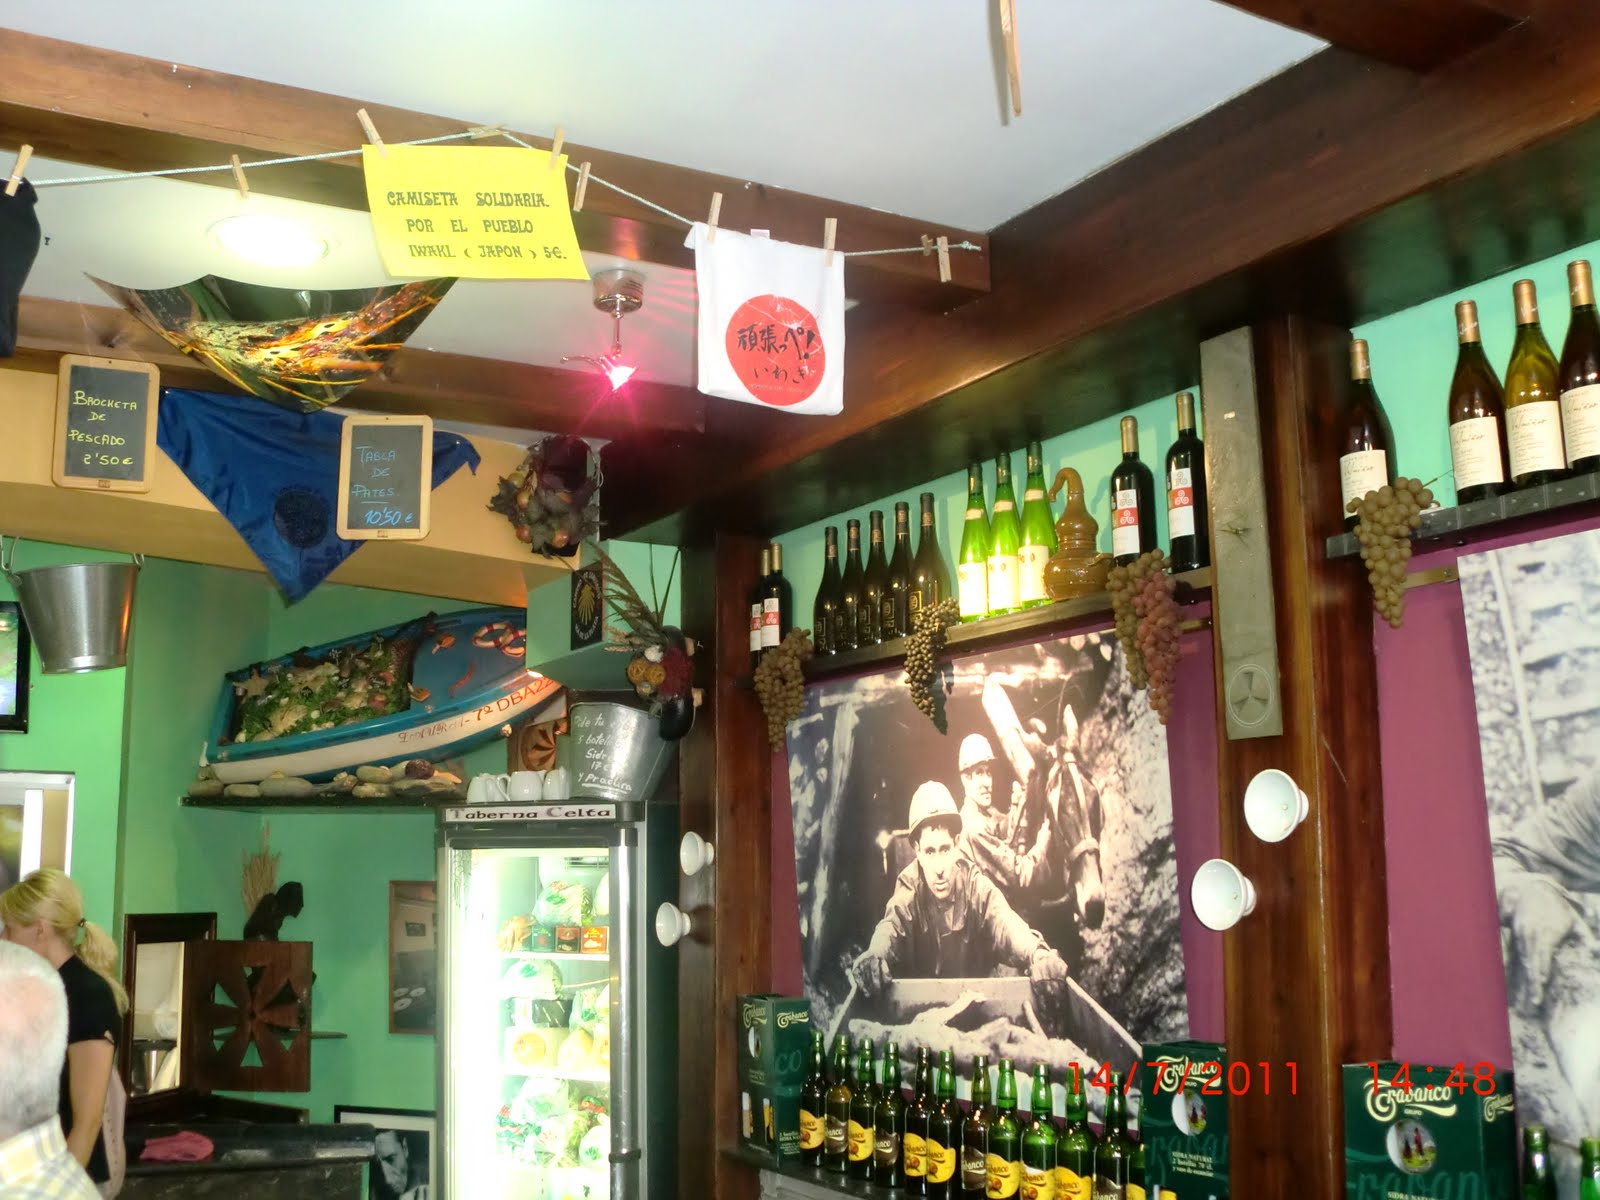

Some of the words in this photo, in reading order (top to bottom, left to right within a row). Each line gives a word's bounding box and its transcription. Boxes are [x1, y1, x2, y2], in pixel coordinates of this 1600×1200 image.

[387, 191, 459, 206] CAMISETA
[406, 218, 435, 233] POR
[450, 219, 468, 233] EL
[482, 219, 534, 234] PUEBLO
[477, 245, 523, 258] JAPON
[88, 411, 106, 421] DE
[68, 429, 126, 446] PESCADO
[355, 446, 396, 466] TABLA
[371, 467, 391, 478] DE
[450, 809, 538, 820] Taberna
[546, 807, 611, 819] Celta
[776, 1010, 810, 1029] Trabanco
[1363, 1079, 1457, 1122] Trabanco
